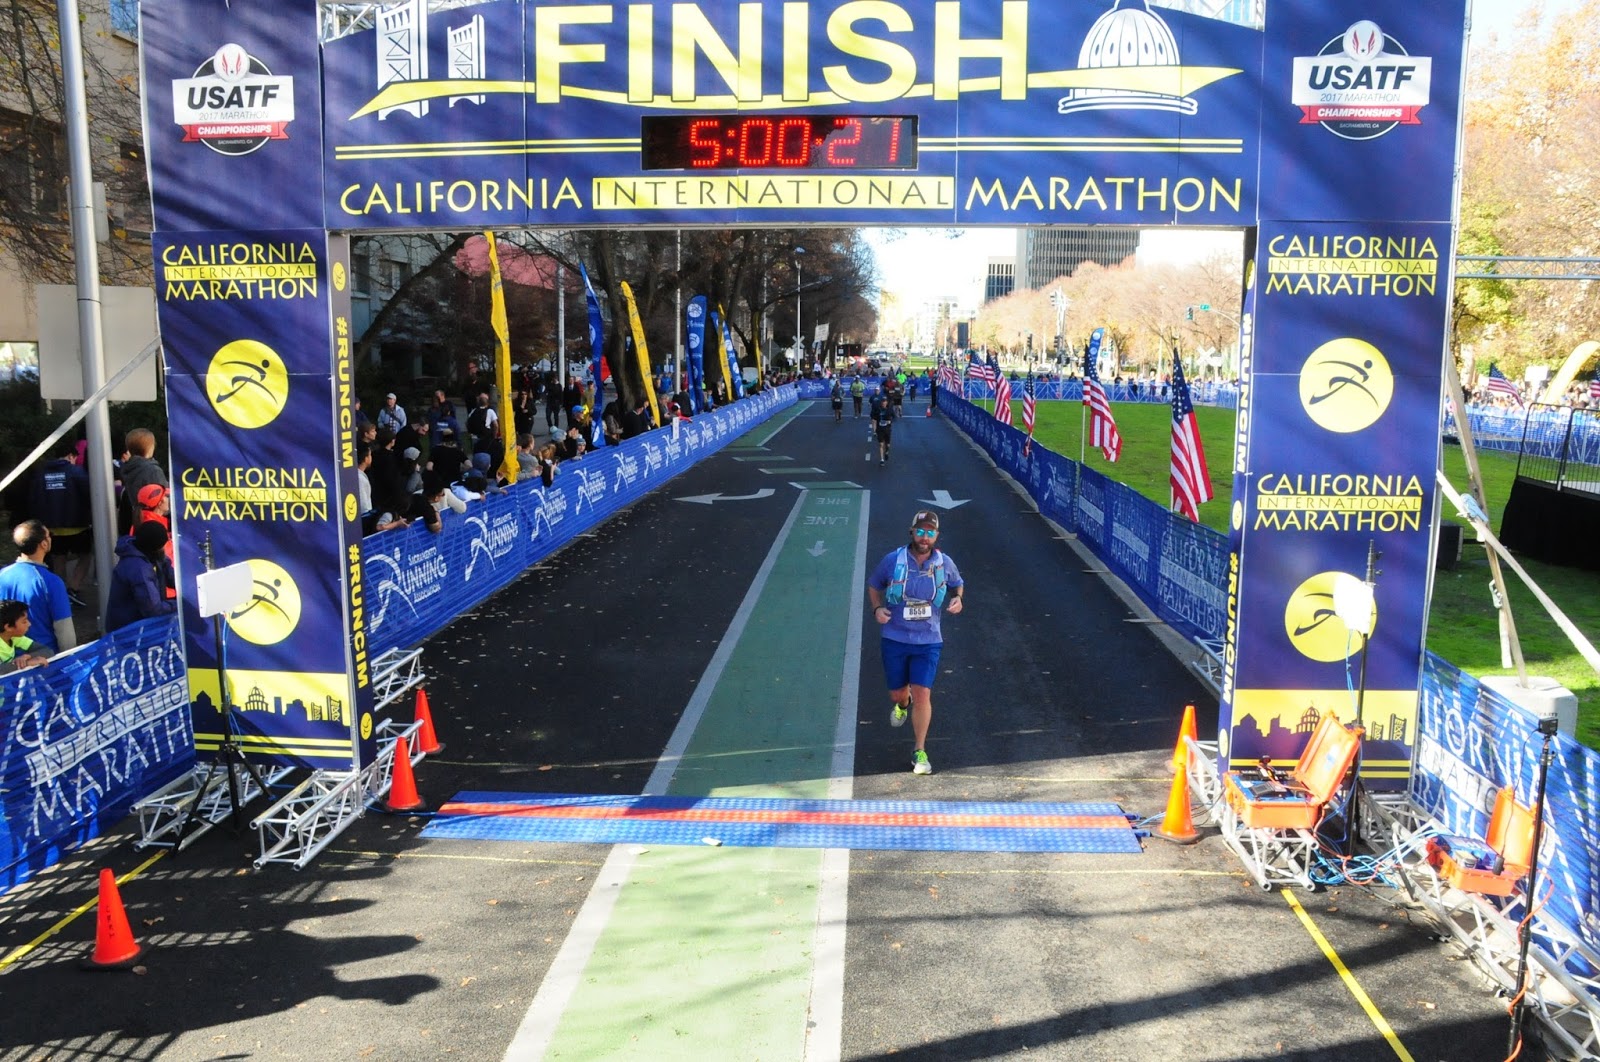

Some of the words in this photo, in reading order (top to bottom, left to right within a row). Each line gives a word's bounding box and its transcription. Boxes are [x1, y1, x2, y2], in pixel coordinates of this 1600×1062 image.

[536, 0, 1028, 103] FINISH
[1308, 65, 1416, 90] USATF
[187, 84, 280, 110] USATF
[1320, 93, 1342, 102] 2017
[1345, 93, 1401, 102] MARATHON
[199, 112, 219, 120] 2017
[220, 111, 269, 120] MARATHON
[1317, 108, 1402, 117] CHAMPIONSHIPS
[197, 125, 272, 135] CHAMPIONSHIPS
[340, 177, 583, 215] CALIFORNIA
[596, 178, 949, 207] INTERNATIONAL
[965, 176, 1242, 213] MARATHON
[162, 242, 317, 266] CALIFORNIA
[1268, 235, 1439, 258] CALIFORNIA
[166, 265, 315, 280] INTERNATIONAL
[1270, 259, 1434, 273] INTERNATIONAL
[165, 278, 317, 301] MARATHON
[1265, 273, 1436, 297] MARATHON
[336, 316, 354, 469] #RUNCIM
[1236, 313, 1251, 473] #RUNCIM
[181, 467, 327, 488] CALIFORNIA
[1257, 473, 1424, 496] CALIFORNIA
[185, 489, 324, 501] INTERNATIONAL
[1259, 497, 1419, 510] INTERNATIONAL
[183, 501, 328, 522] MARATHON
[1254, 510, 1421, 532] MARATHON
[348, 543, 369, 689] #RUNCIM
[1223, 552, 1239, 705] #RUNCIM
